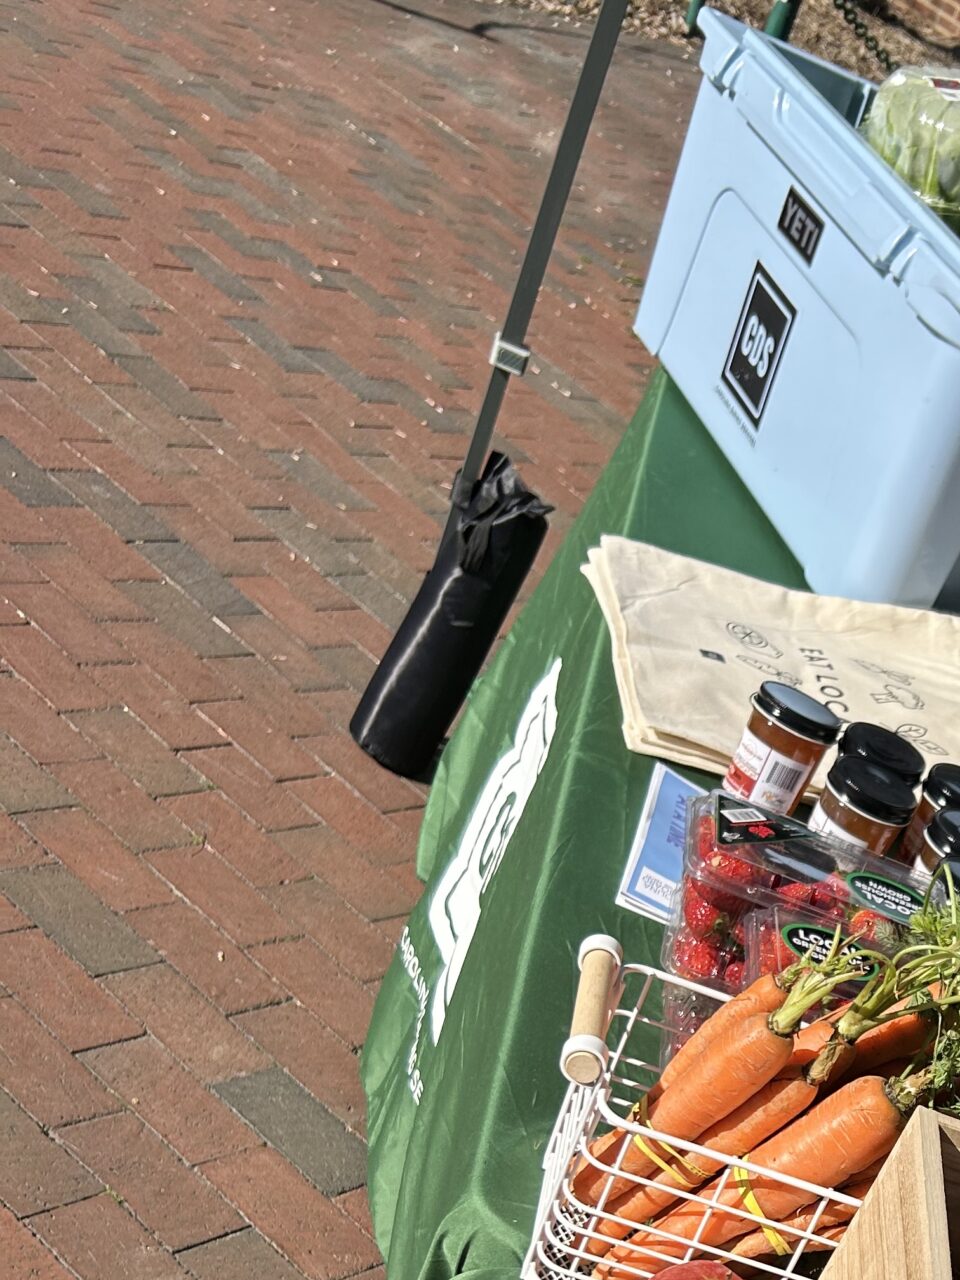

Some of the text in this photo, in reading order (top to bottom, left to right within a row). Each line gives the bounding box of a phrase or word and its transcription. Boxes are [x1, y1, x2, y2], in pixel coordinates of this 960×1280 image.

[781, 196, 820, 256] YETI
[741, 314, 775, 379] CDS
[799, 647, 851, 722] EAT LOC
[854, 880, 922, 910] REENHOUSE
[861, 890, 917, 915] OCAL
[868, 880, 911, 902] GROWN
